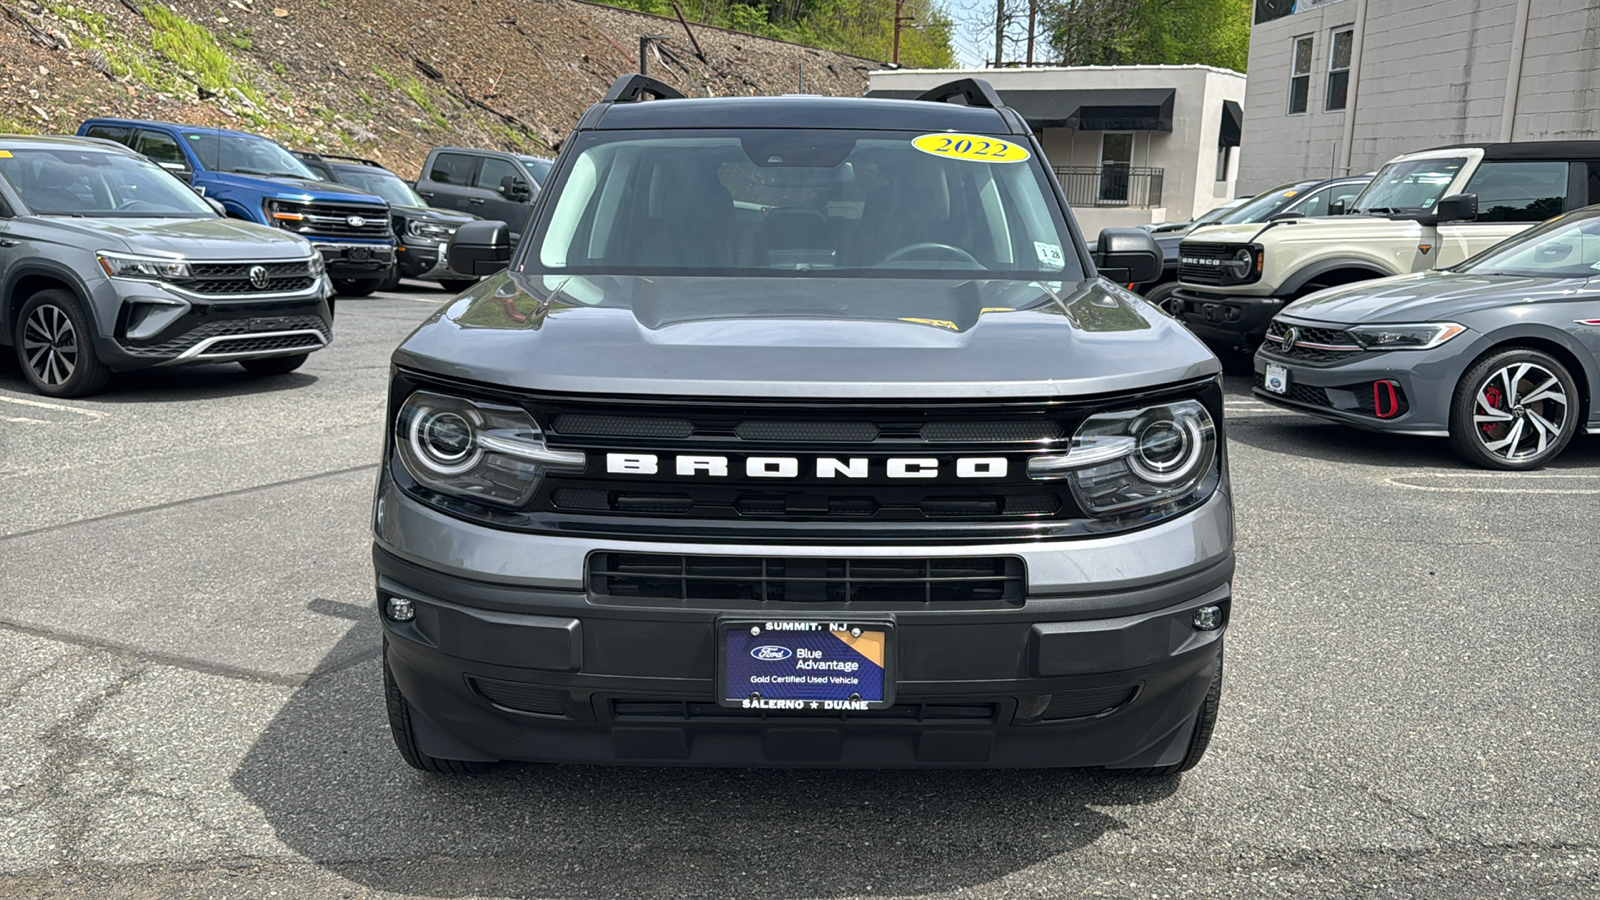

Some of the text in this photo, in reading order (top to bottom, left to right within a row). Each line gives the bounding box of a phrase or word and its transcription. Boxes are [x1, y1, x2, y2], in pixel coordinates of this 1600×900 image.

[934, 138, 1008, 157] 2022
[606, 453, 1008, 478] BRONCO
[765, 622, 848, 631] SUMMIT, NJ
[758, 647, 784, 658] Ford
[797, 648, 822, 658] Blue
[796, 660, 859, 671] Advantage
[750, 675, 859, 685] Gold Certified Used Vehicle
[742, 700, 869, 710] SALERNO DUANE
